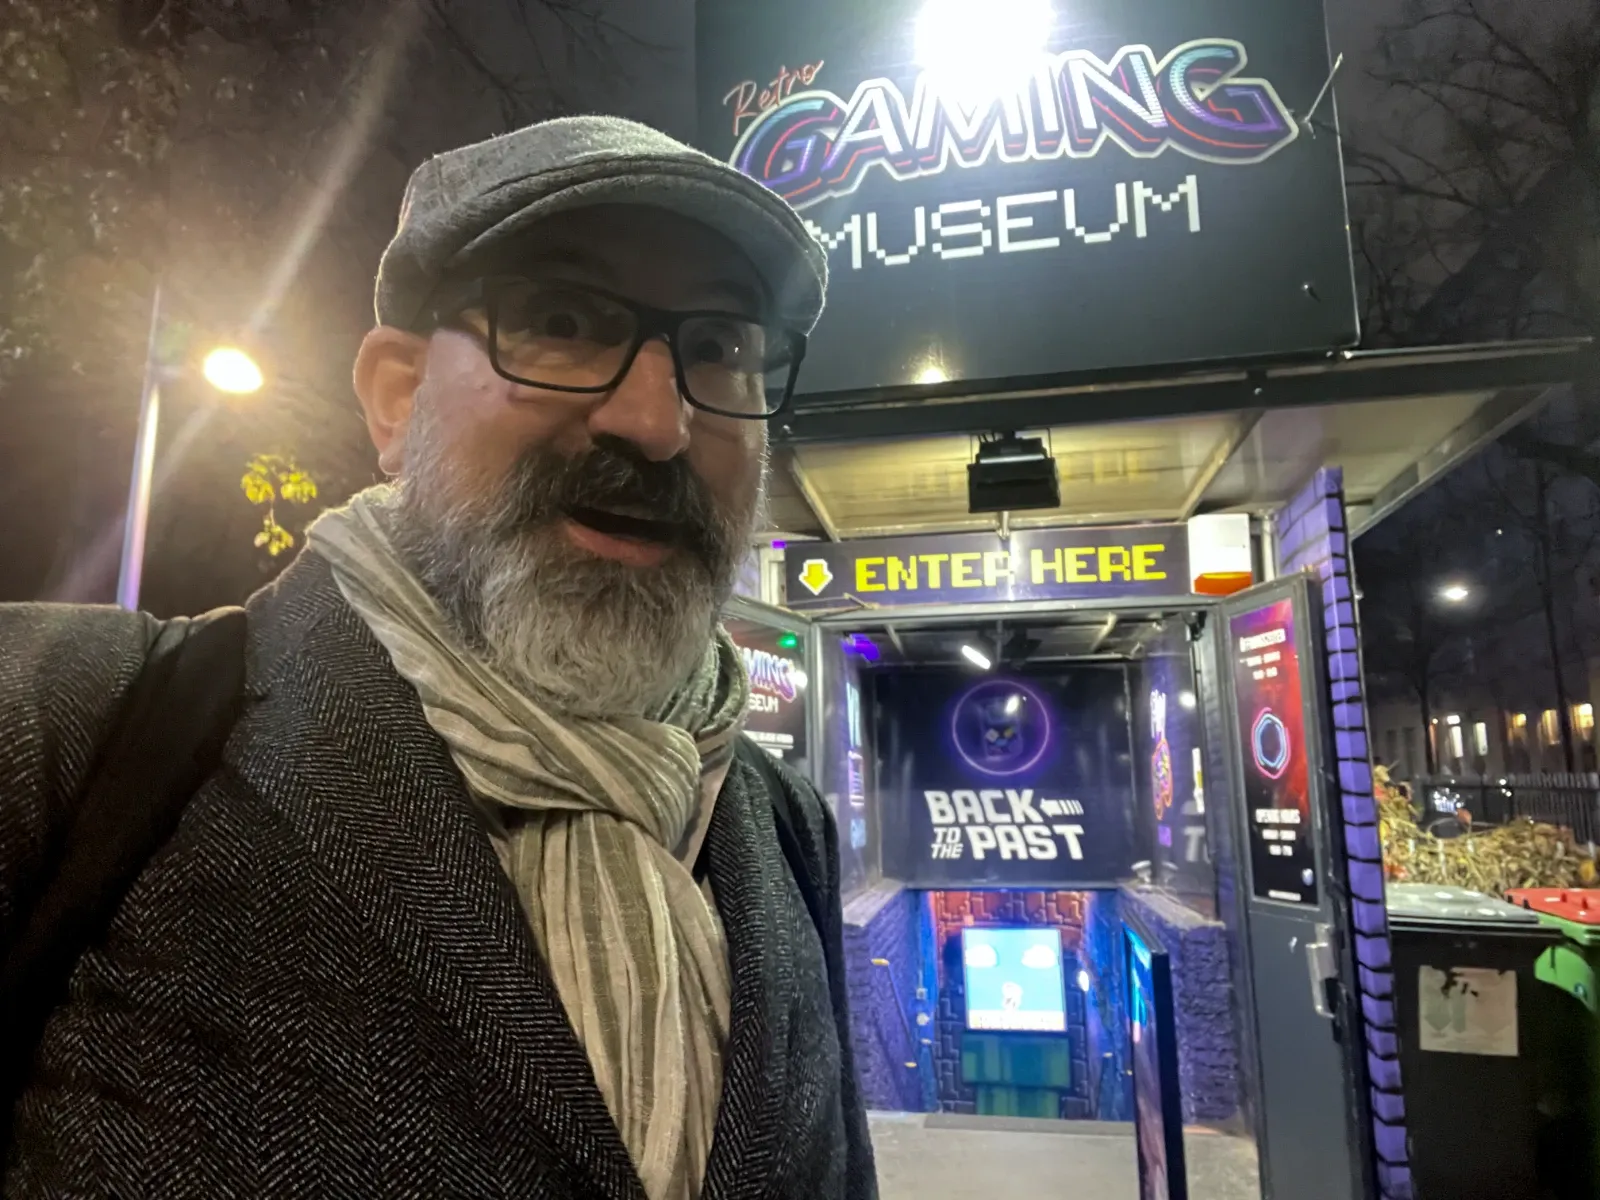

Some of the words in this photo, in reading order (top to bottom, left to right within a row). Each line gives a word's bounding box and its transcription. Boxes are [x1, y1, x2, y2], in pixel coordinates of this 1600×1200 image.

[723, 60, 824, 136] Retro
[728, 39, 1300, 211] GAMING
[805, 175, 1201, 269] MUSEUM
[855, 551, 1014, 592] ENTER
[1031, 544, 1167, 584] HERE
[748, 692, 780, 713] SEUM
[924, 789, 1044, 825] BACK
[931, 843, 964, 859] THE
[933, 826, 962, 844] TO
[965, 824, 1085, 860] PAST
